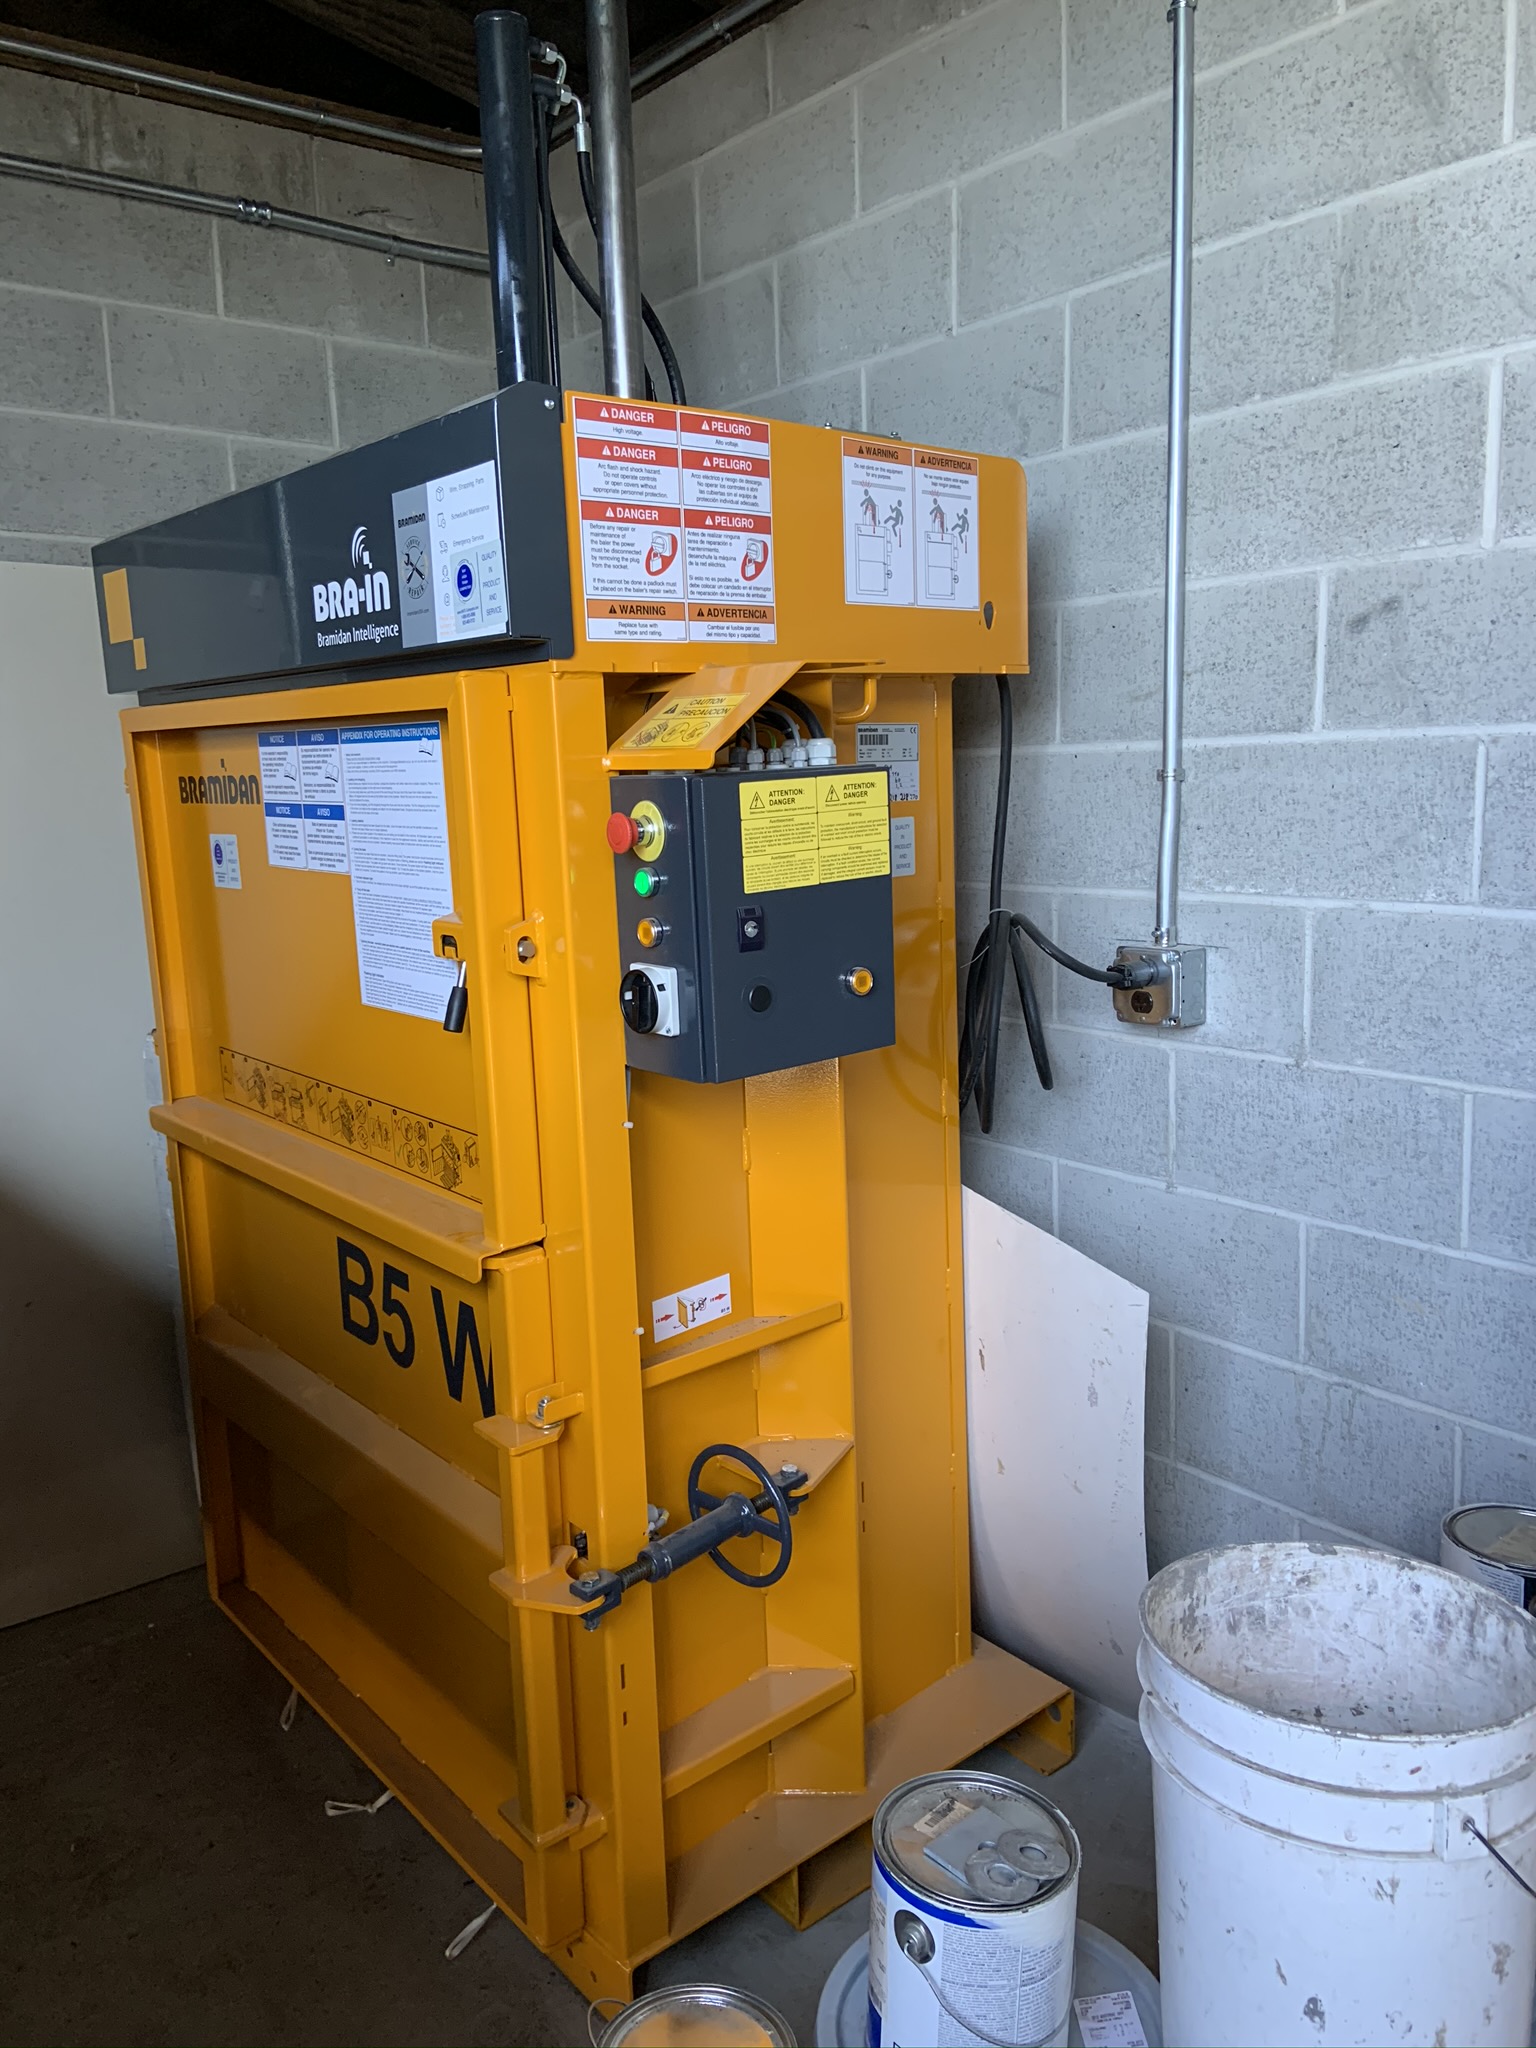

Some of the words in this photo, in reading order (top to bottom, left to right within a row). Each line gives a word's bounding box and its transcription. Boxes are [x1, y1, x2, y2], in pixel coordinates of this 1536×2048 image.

[612, 408, 654, 423] DANGER
[712, 422, 751, 436] PELIGRO
[614, 446, 656, 460] DANGER
[866, 447, 899, 460] WARNING
[713, 458, 752, 471] PELIGRO
[928, 457, 972, 470] ADVERTENCIA
[617, 508, 659, 520] DANGER
[715, 516, 754, 528] PELIGRO
[481, 551, 497, 561] QUALITY
[482, 578, 500, 588] PRODUCT
[312, 571, 391, 622] BRA-IN
[486, 606, 502, 616] SERVICE
[619, 605, 666, 616] WARNING
[707, 608, 767, 619] ADVERTENCIA
[317, 628, 352, 648] Bramidan
[353, 624, 399, 644] Intelligence
[270, 735, 285, 743] NOTICE
[311, 734, 324, 742] AVISO
[342, 731, 363, 740] APPENDIX
[364, 730, 374, 739] FOR
[374, 729, 401, 738] OPERATING
[402, 727, 438, 737] INSTRUCTIONS
[843, 782, 876, 791] ATTENTION:
[769, 788, 804, 798] ATTENTION:
[843, 791, 868, 799] DANGER
[769, 798, 796, 806] DANGER
[276, 807, 291, 815] NOTICE
[317, 808, 330, 816] AVISO
[337, 1236, 416, 1369] B5
[430, 1285, 496, 1419] W
